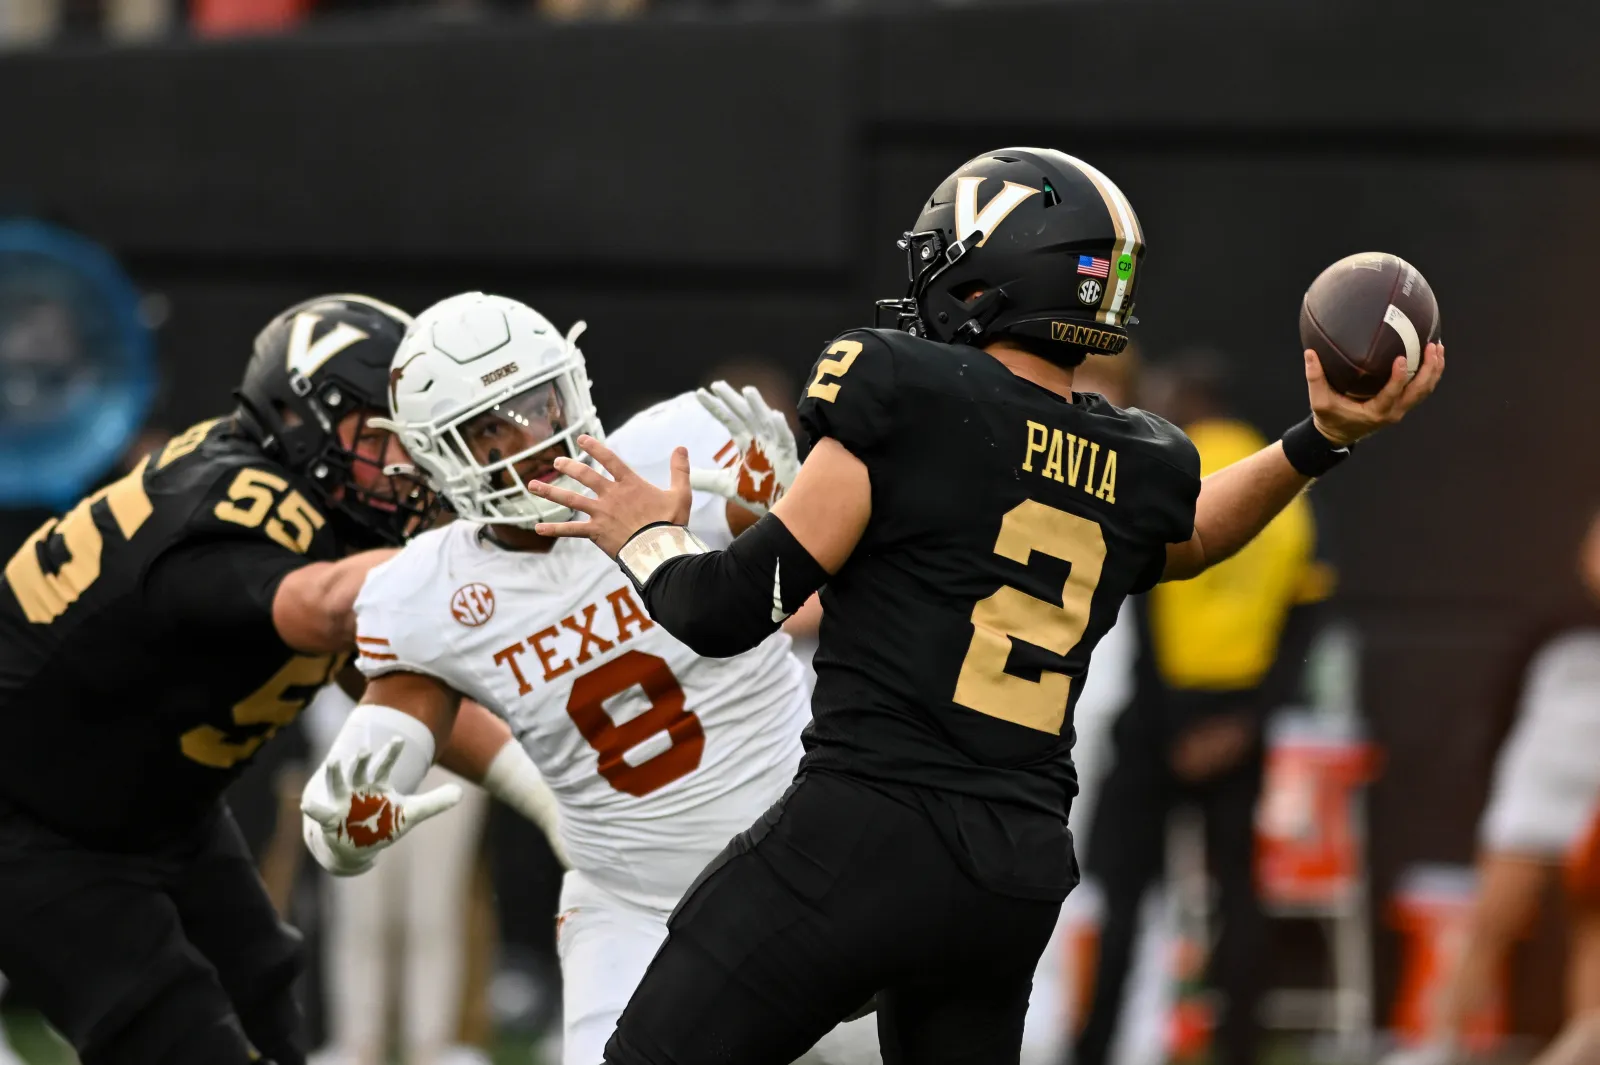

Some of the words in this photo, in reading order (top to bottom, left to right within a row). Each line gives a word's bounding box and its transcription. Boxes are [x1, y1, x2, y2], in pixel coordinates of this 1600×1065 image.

[955, 176, 1042, 248] V
[1079, 279, 1101, 303] SEC
[1118, 261, 1131, 272] C2P
[286, 311, 371, 378] V
[480, 361, 519, 387] HORNS
[806, 339, 863, 403] 2
[1022, 419, 1118, 505] PAVIA
[213, 466, 327, 555] 55
[451, 583, 495, 626] SEC
[952, 498, 1108, 736] 2
[493, 585, 655, 697] TEXA
[566, 649, 706, 798] 8
